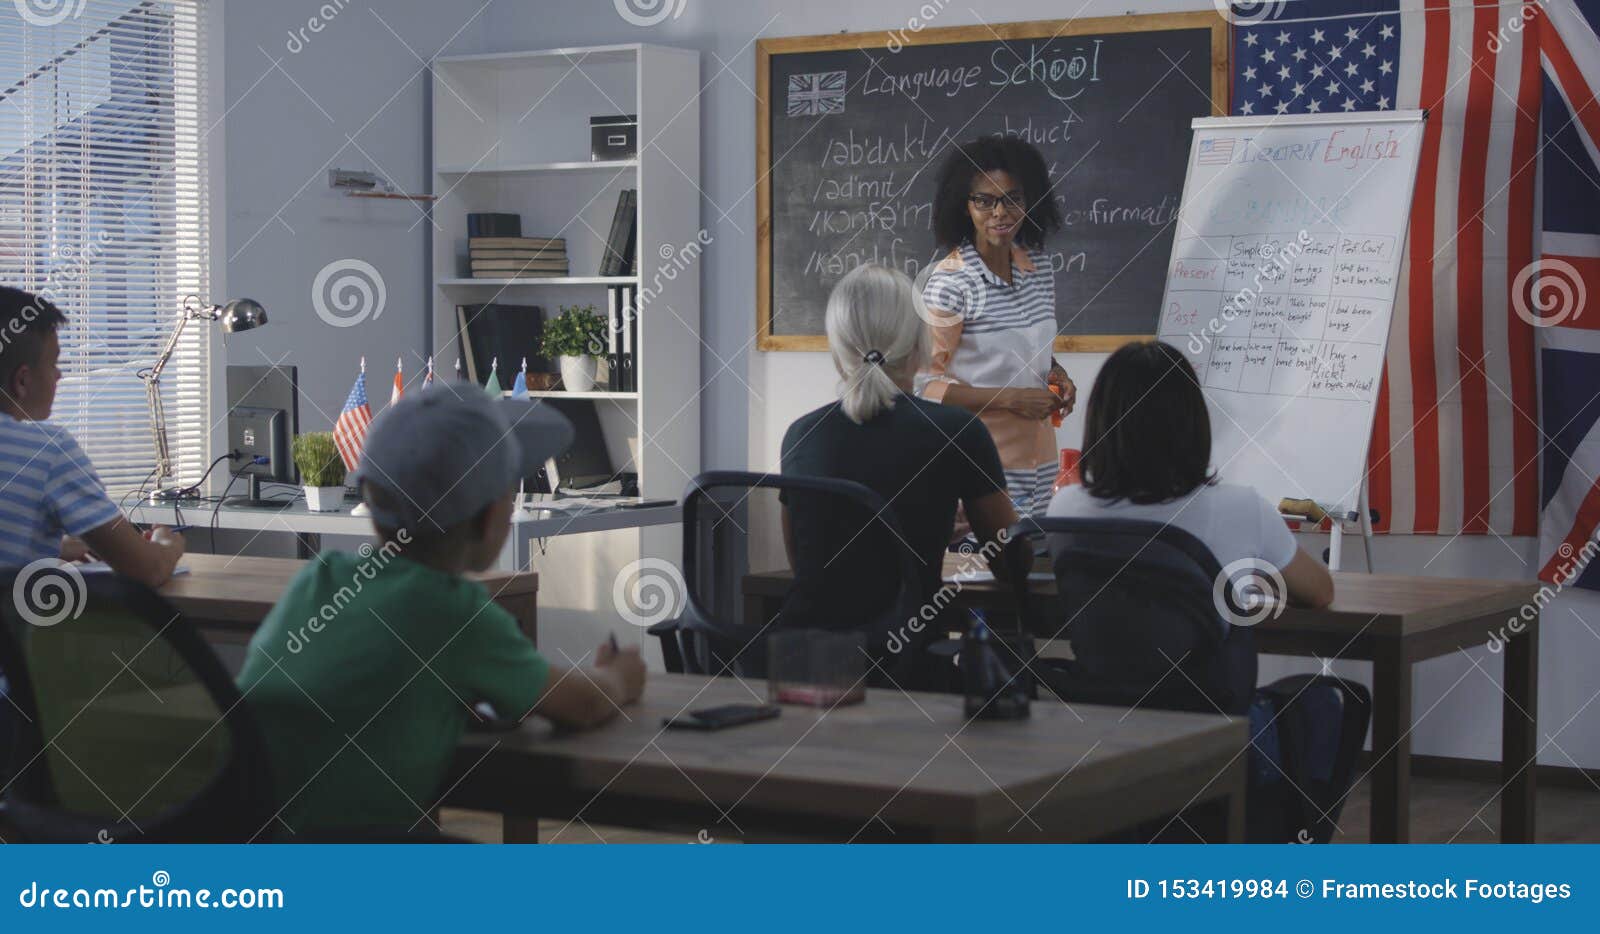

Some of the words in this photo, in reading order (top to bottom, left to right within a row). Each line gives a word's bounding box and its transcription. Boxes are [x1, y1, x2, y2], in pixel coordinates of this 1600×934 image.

[863, 59, 983, 99] Language
[1324, 128, 1401, 169] English
[1175, 261, 1217, 279] Present
[1167, 302, 1198, 325] Past
